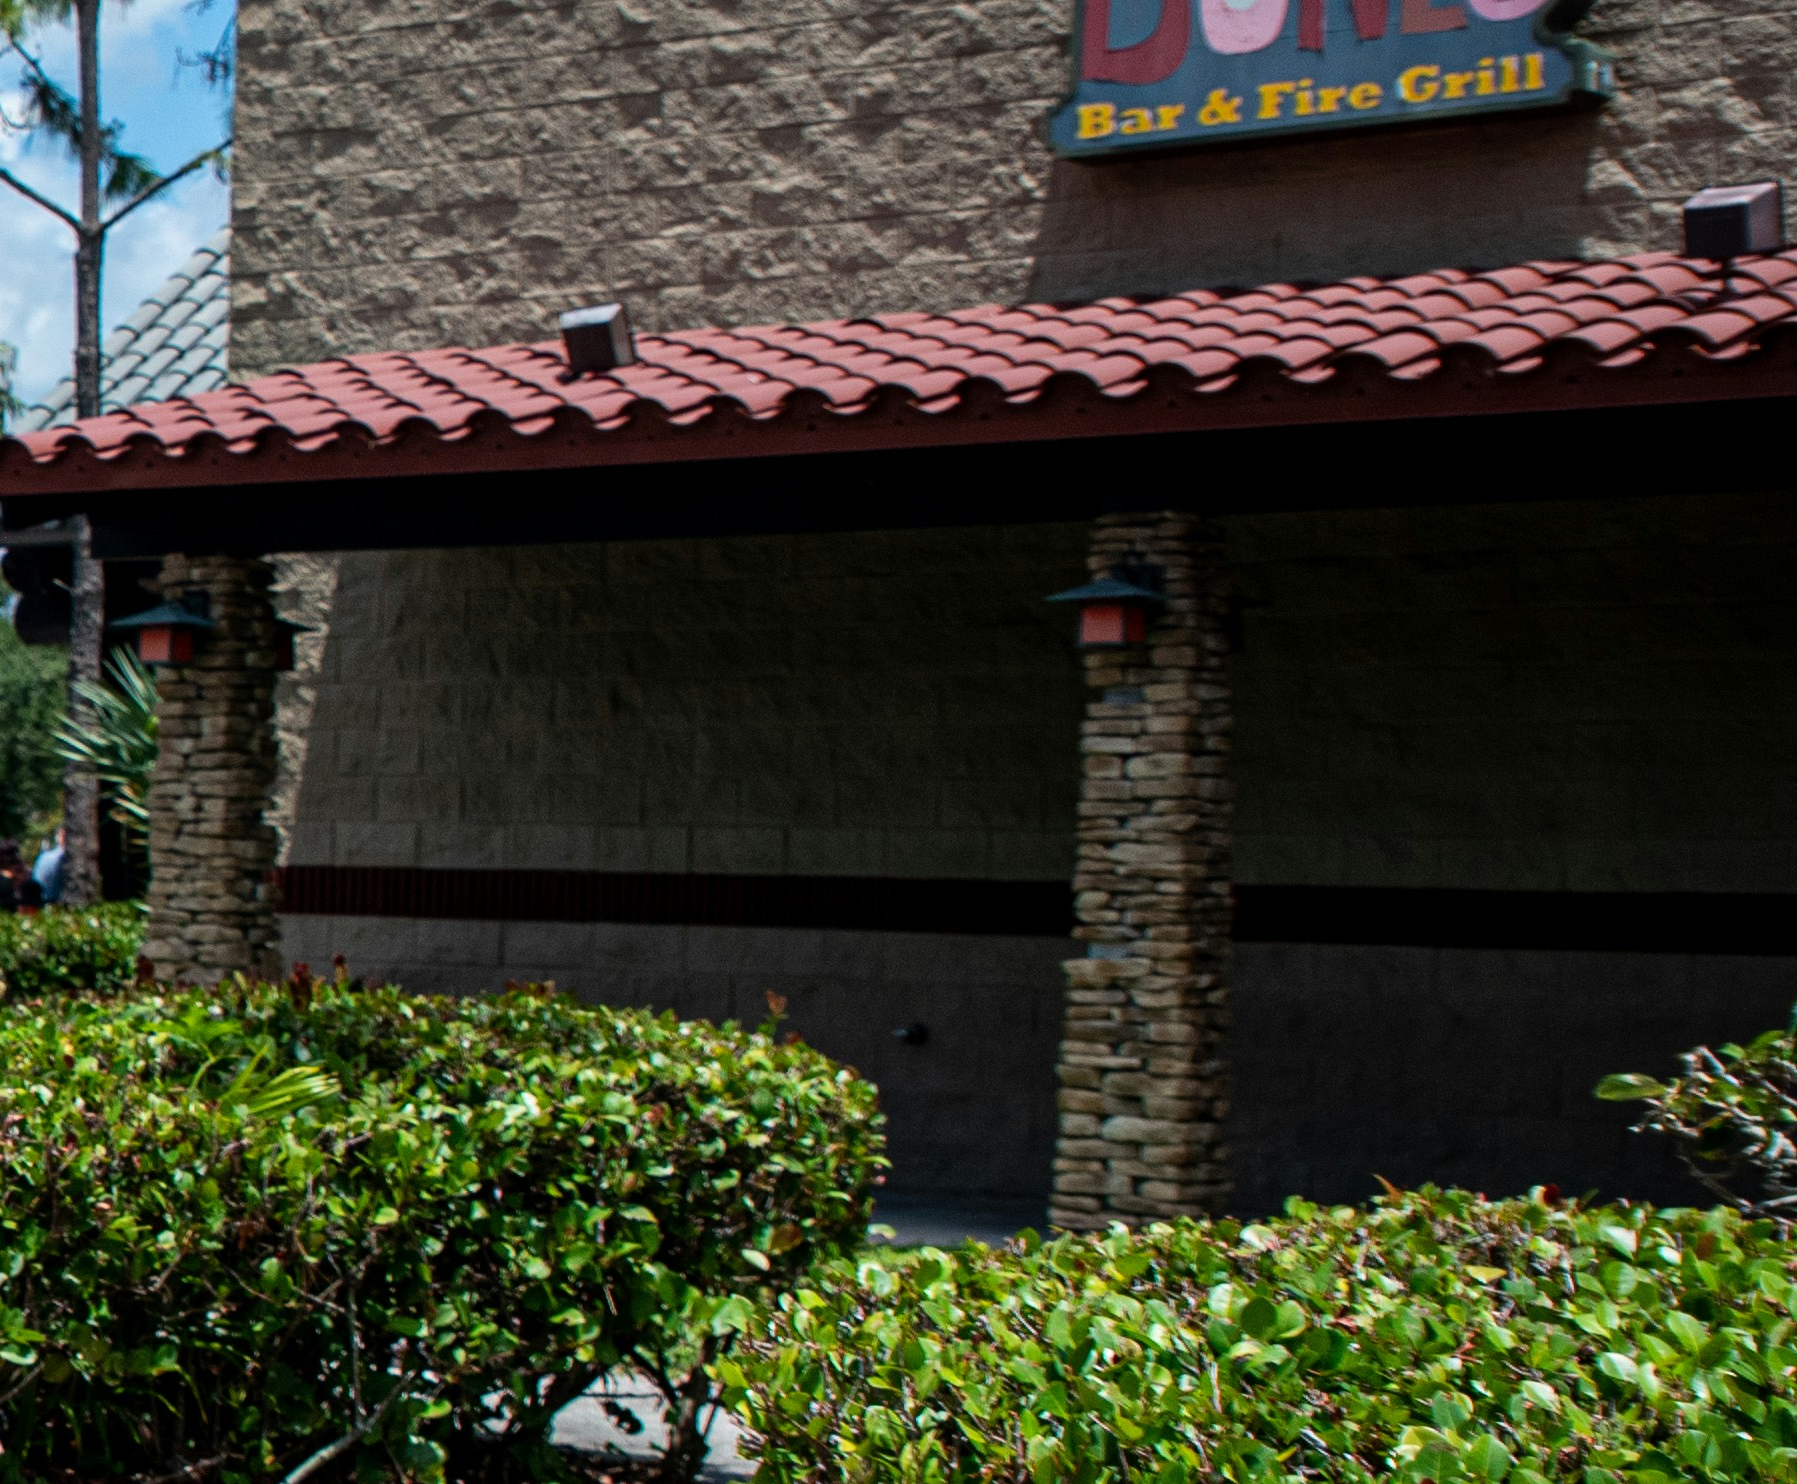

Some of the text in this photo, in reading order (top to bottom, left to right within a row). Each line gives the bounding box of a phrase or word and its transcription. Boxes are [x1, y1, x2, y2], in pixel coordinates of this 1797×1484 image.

[1076, 52, 1546, 140] Bar & Fire Grill
